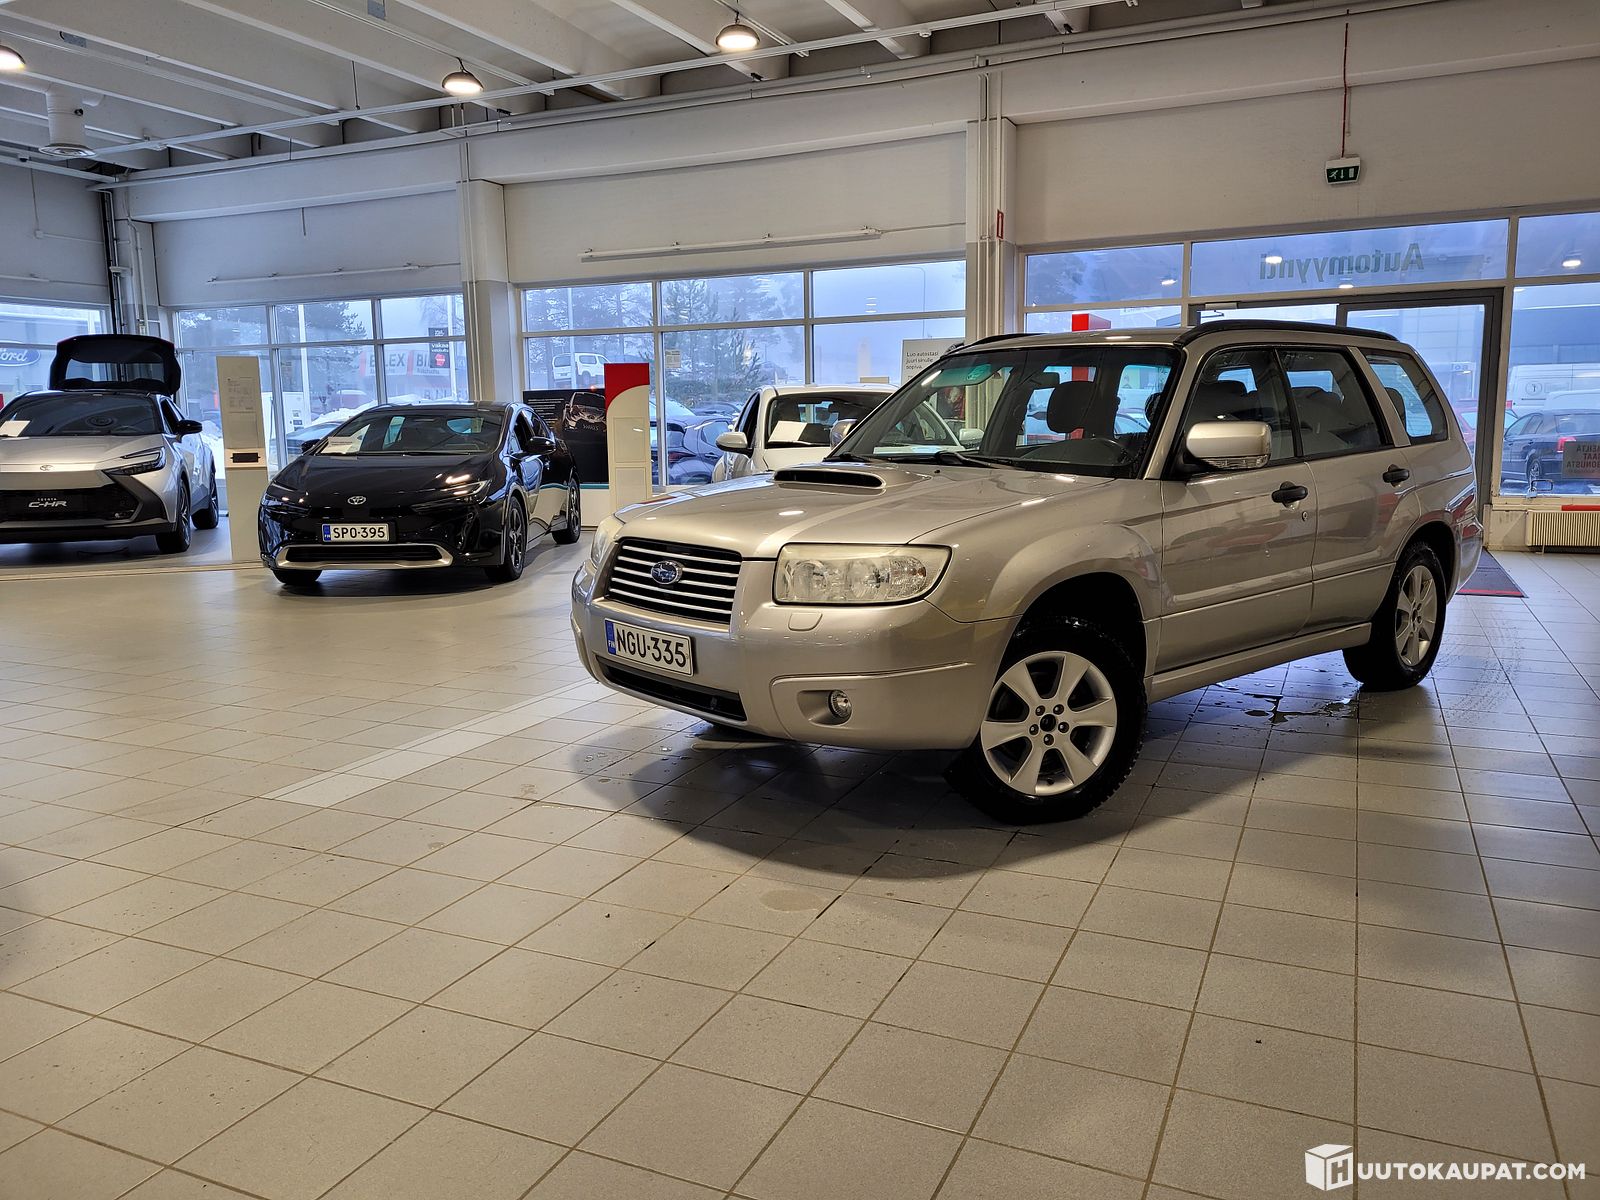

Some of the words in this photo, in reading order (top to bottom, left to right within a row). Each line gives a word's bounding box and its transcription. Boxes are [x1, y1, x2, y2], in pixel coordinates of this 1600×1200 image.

[0, 348, 28, 362] ord
[369, 353, 405, 367] BEX
[616, 628, 686, 668] NGU-335
